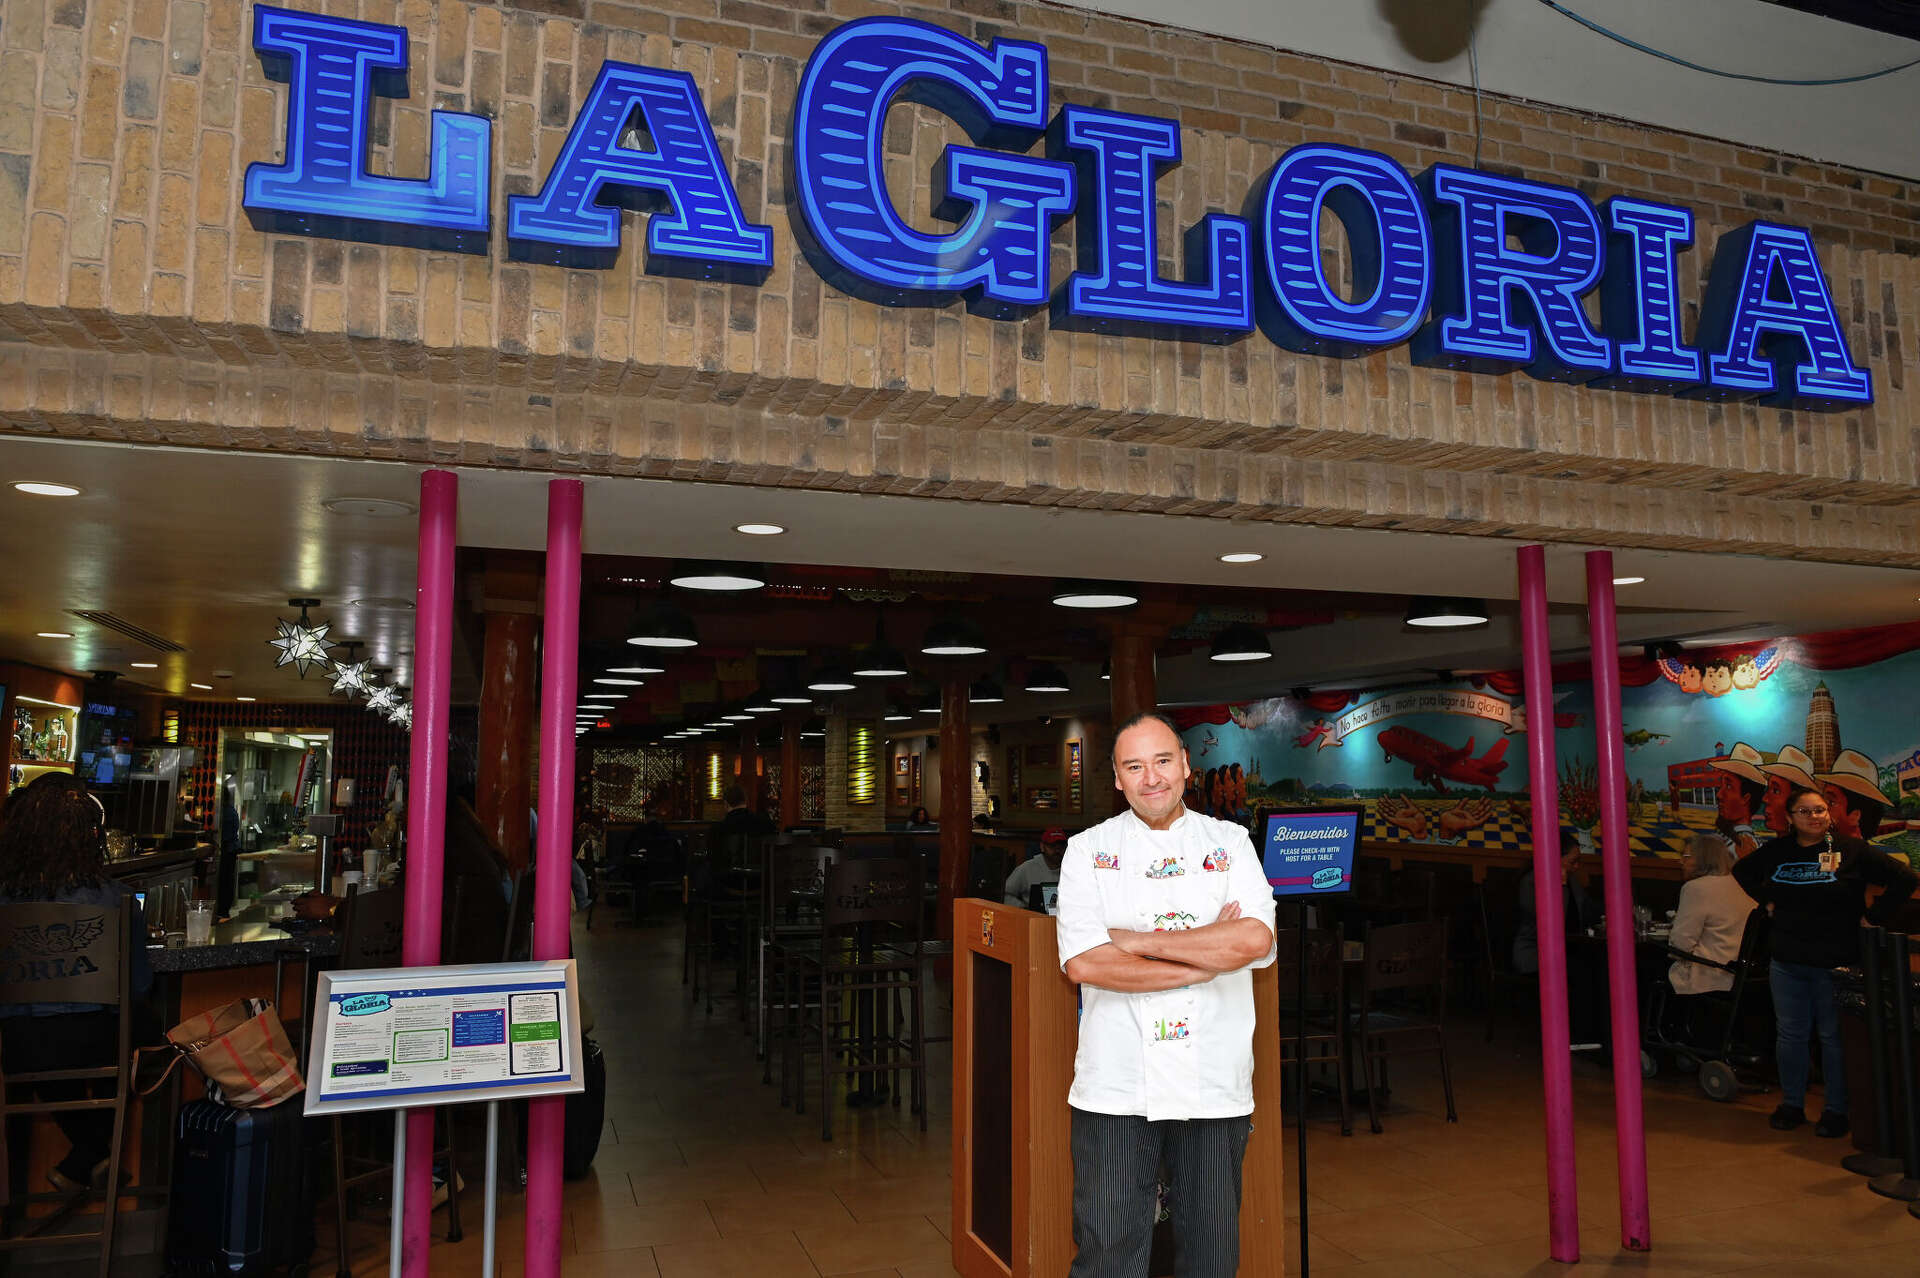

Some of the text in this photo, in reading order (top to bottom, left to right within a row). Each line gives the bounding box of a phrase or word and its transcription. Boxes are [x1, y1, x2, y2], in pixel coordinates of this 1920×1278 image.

[243, 3, 1874, 404] LA GLORIA
[1477, 699, 1504, 716] gloria
[1273, 825, 1349, 842] Bienvenidos
[345, 1000, 386, 1012] GLORIA
